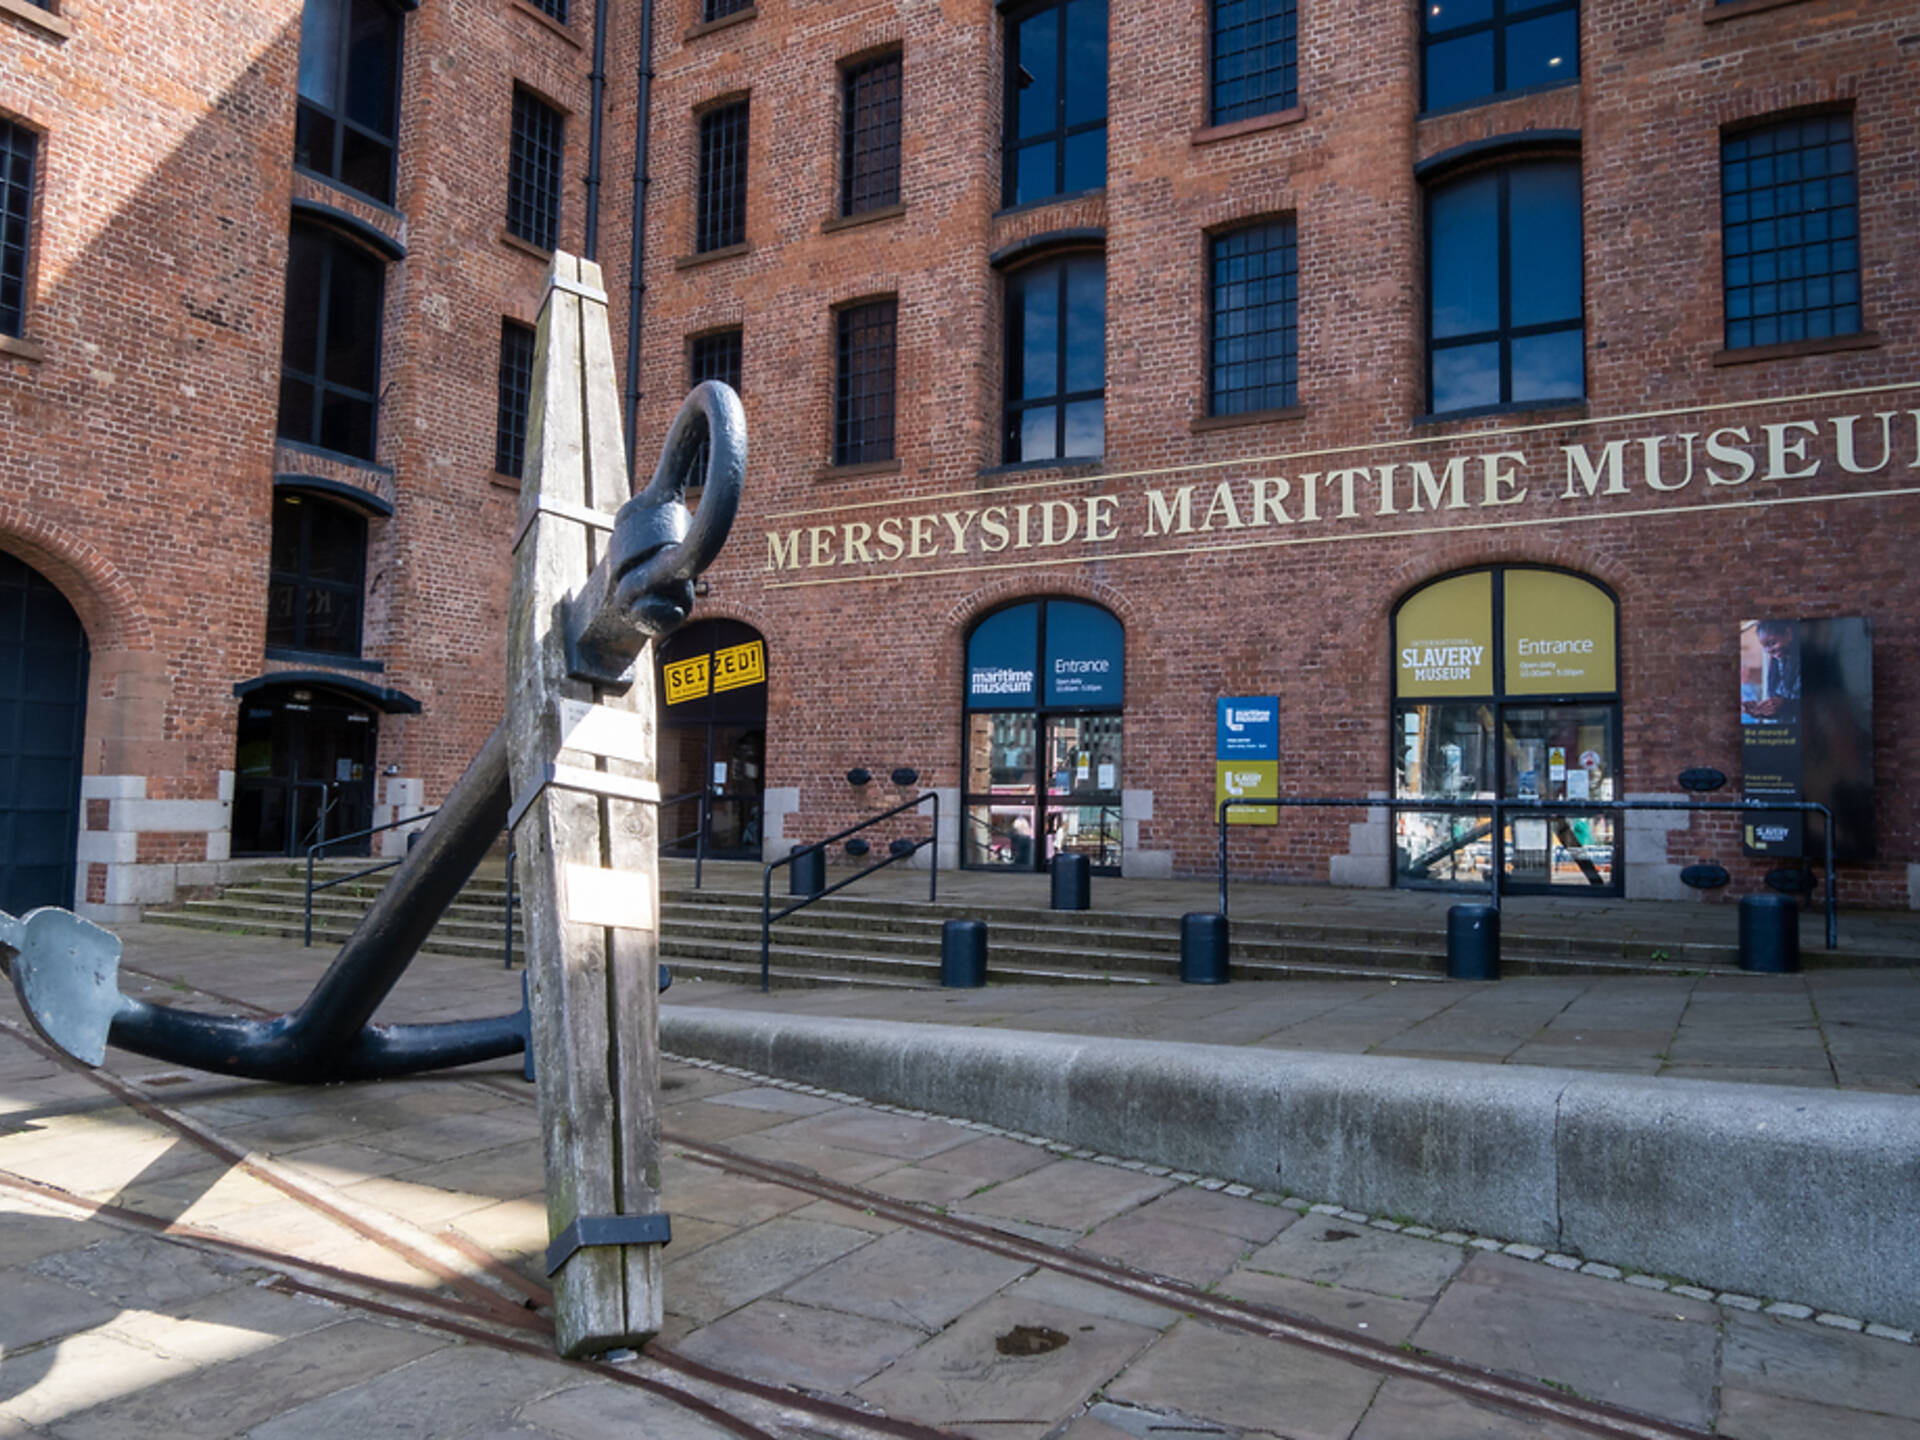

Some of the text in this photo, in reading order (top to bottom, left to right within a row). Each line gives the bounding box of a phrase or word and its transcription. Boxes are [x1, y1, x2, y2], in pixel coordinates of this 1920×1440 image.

[764, 408, 1920, 571] MERSEYSIDE MARITIME MUSEU
[1518, 638, 1593, 656] Entrance
[1402, 646, 1484, 668] SLAVERY
[1055, 659, 1110, 673] Entrance
[972, 669, 1034, 684] maritime
[1415, 667, 1471, 681] MUSEUM
[972, 682, 1031, 694] museum
